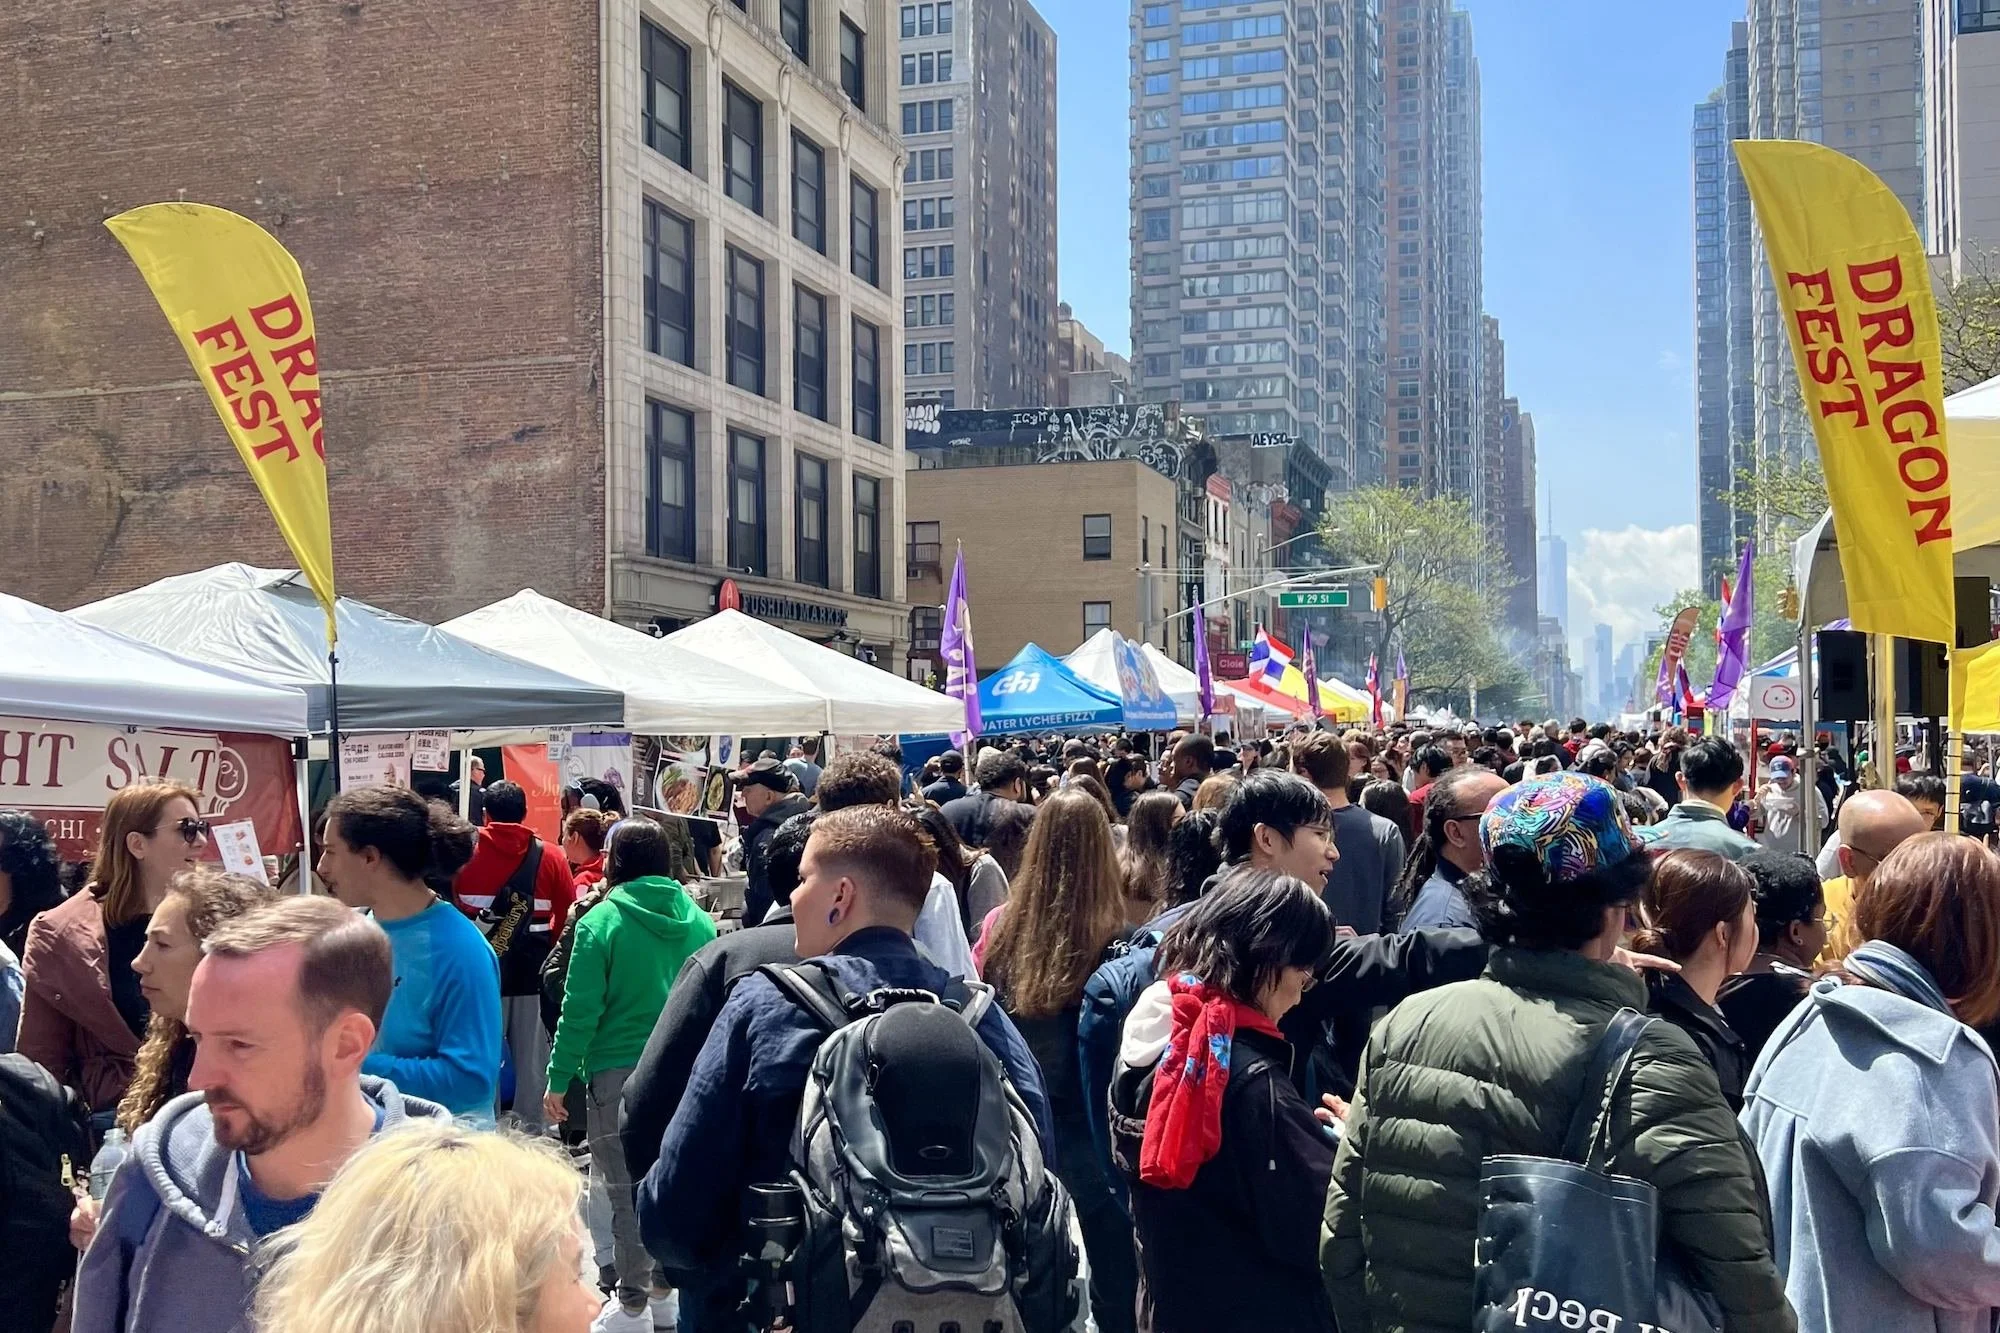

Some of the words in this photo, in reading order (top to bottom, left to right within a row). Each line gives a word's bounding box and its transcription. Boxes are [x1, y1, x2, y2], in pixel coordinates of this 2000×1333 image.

[193, 316, 300, 464] FEST
[1787, 268, 1869, 429] FEST
[1847, 254, 1952, 548] DRAGON
[742, 594, 799, 621] FUSHIMI
[800, 603, 848, 627] MARKET
[1297, 594, 1304, 604] W
[1307, 594, 1317, 604] 29
[1320, 594, 1329, 604] St
[1019, 714, 1062, 728] LYCHEE
[1065, 711, 1097, 723] FIZZY
